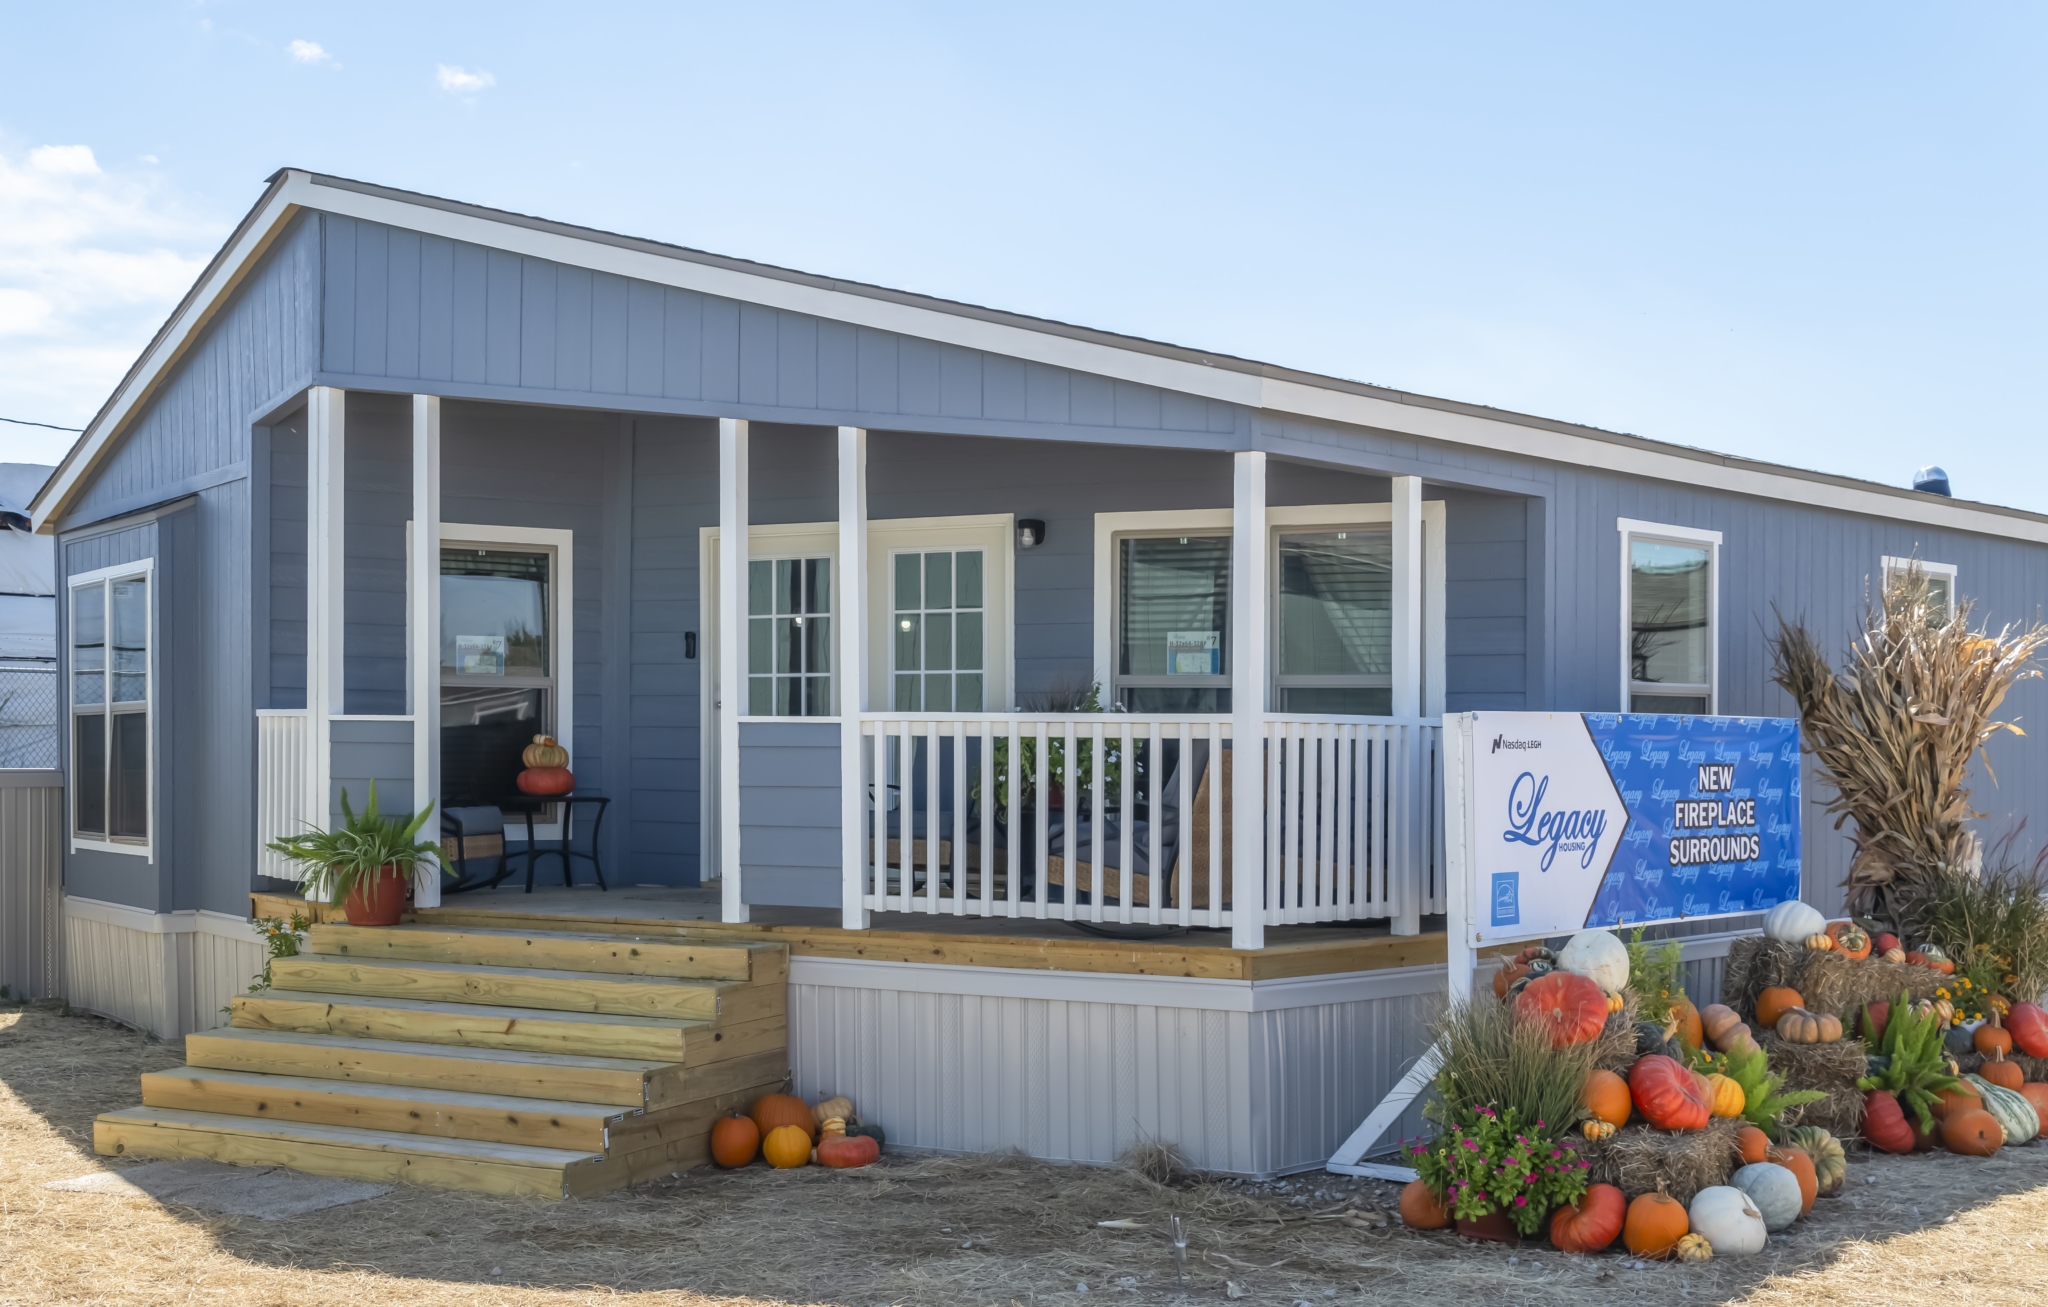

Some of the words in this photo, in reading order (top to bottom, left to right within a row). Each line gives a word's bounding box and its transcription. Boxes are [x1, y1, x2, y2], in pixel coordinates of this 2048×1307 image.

[1640, 739, 1670, 769] Legacy
[1678, 740, 1706, 768] Legacy
[1748, 741, 1774, 770] Legacy
[1699, 766, 1734, 790] NEW
[1757, 778, 1783, 805] Legacy
[1651, 778, 1680, 808] Legacy
[1503, 772, 1608, 872] Legacy
[1675, 801, 1755, 828] FIREPLACE
[1767, 814, 1792, 841] Legacy
[1558, 842, 1586, 852] HOUSING
[1669, 836, 1760, 864] SURROUNDS
[1603, 872, 1626, 892] egacy
[1634, 859, 1663, 888] Legacy
